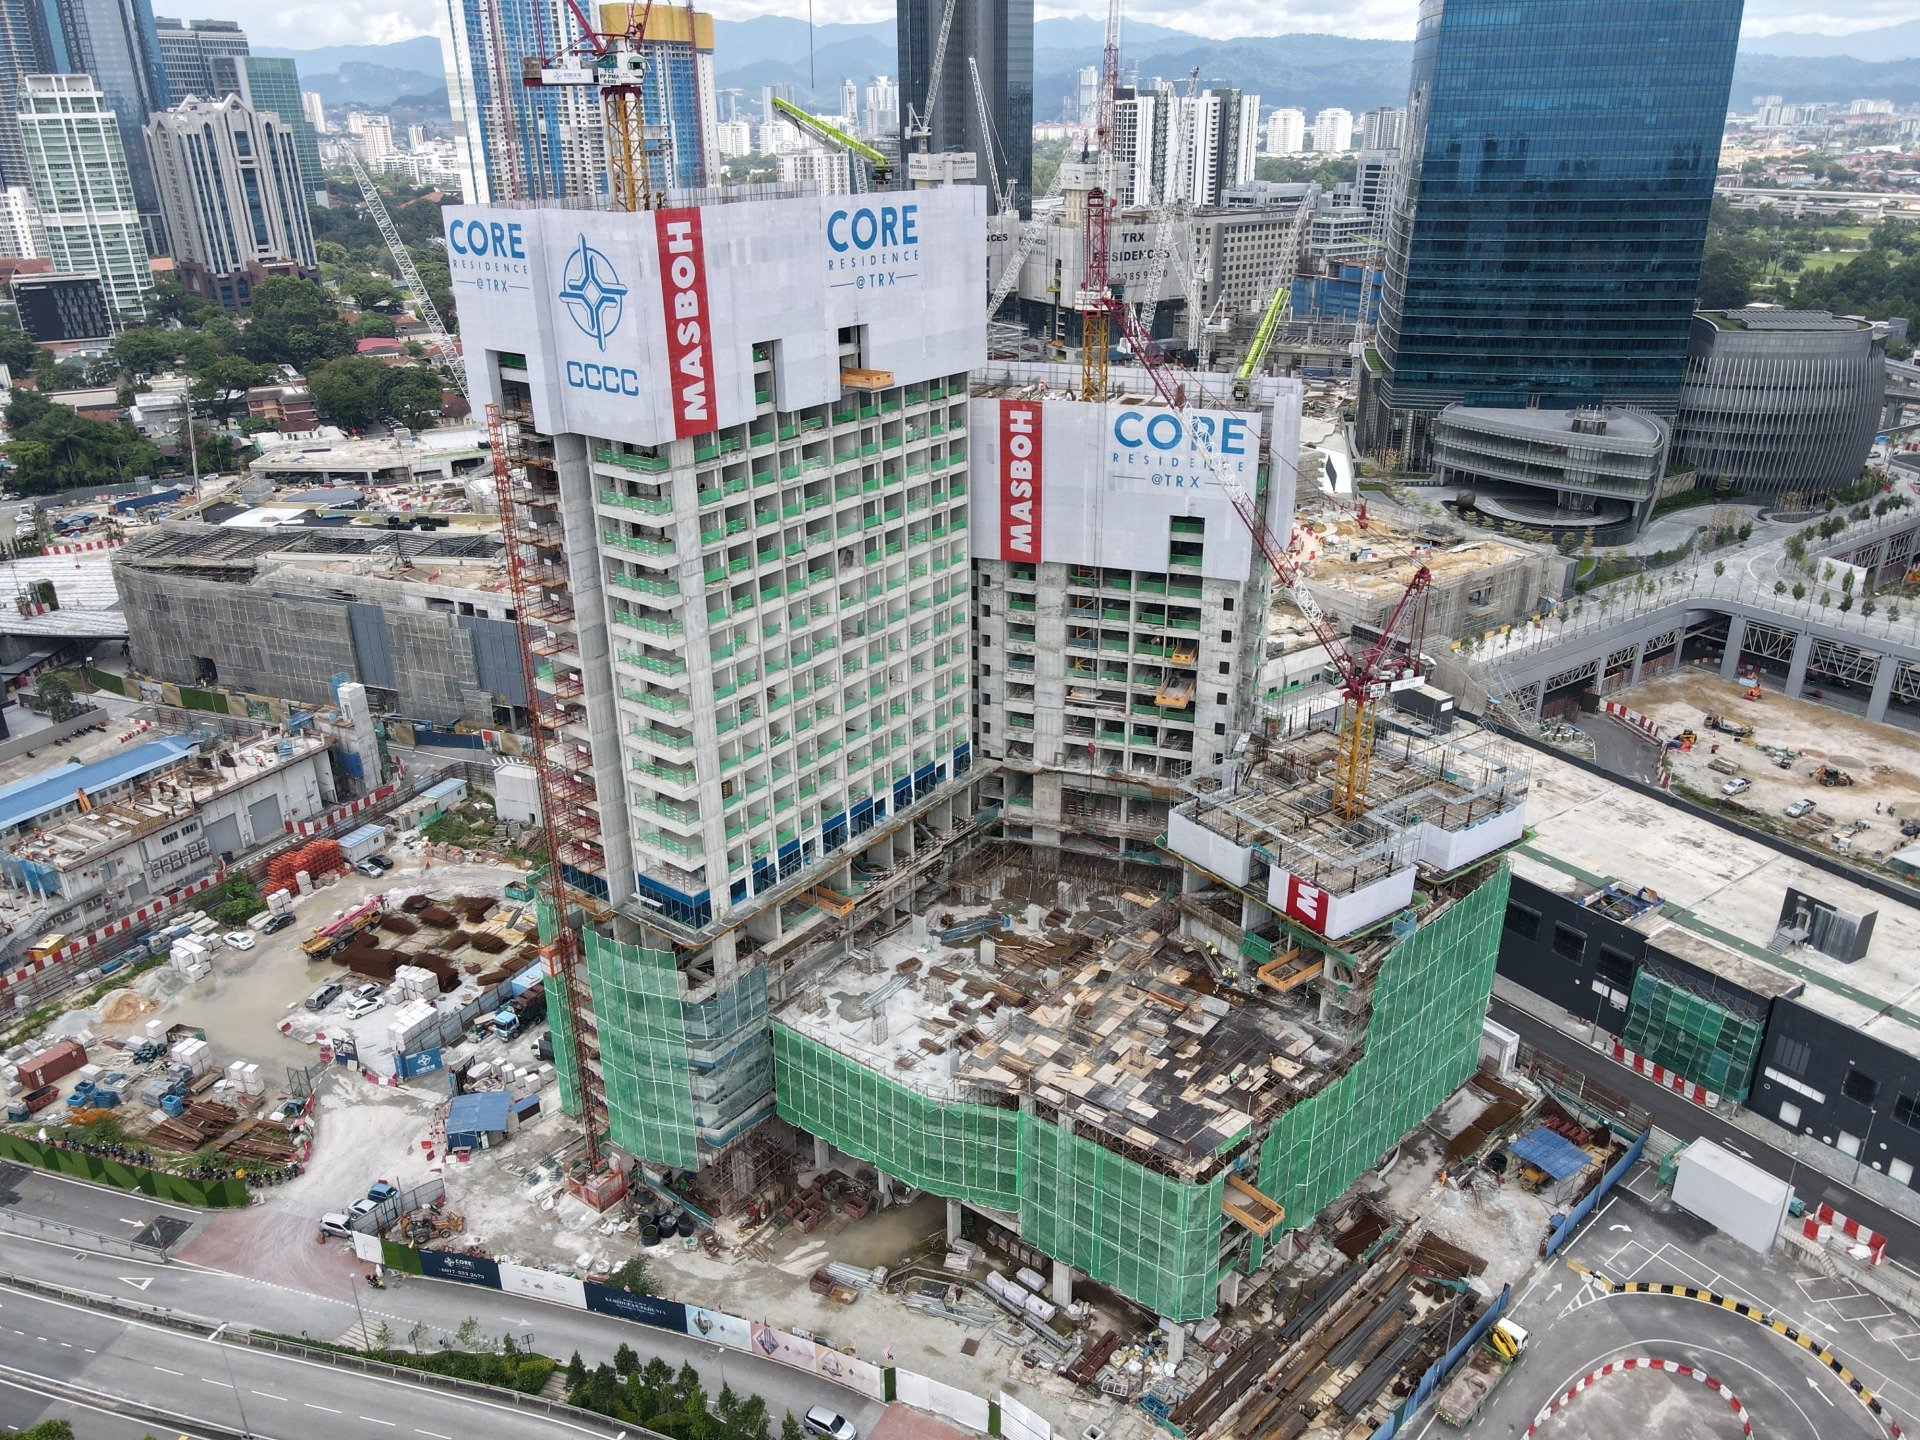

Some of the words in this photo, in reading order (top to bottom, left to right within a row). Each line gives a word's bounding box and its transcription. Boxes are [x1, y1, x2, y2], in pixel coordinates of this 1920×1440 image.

[449, 219, 526, 259] CORE
[827, 204, 919, 253] CORE
[1122, 232, 1146, 243] TRX
[453, 259, 528, 274] RESIDENCE
[828, 250, 919, 271] RESIDENCE
[476, 278, 508, 292] @TRX
[856, 271, 896, 290] @TRX
[667, 221, 707, 421] MASBOH
[566, 360, 639, 396] CCCC
[1114, 411, 1247, 455] CORE
[1010, 410, 1033, 554] MASBOH
[1151, 473, 1200, 489] @TRX
[1296, 883, 1319, 920] M
